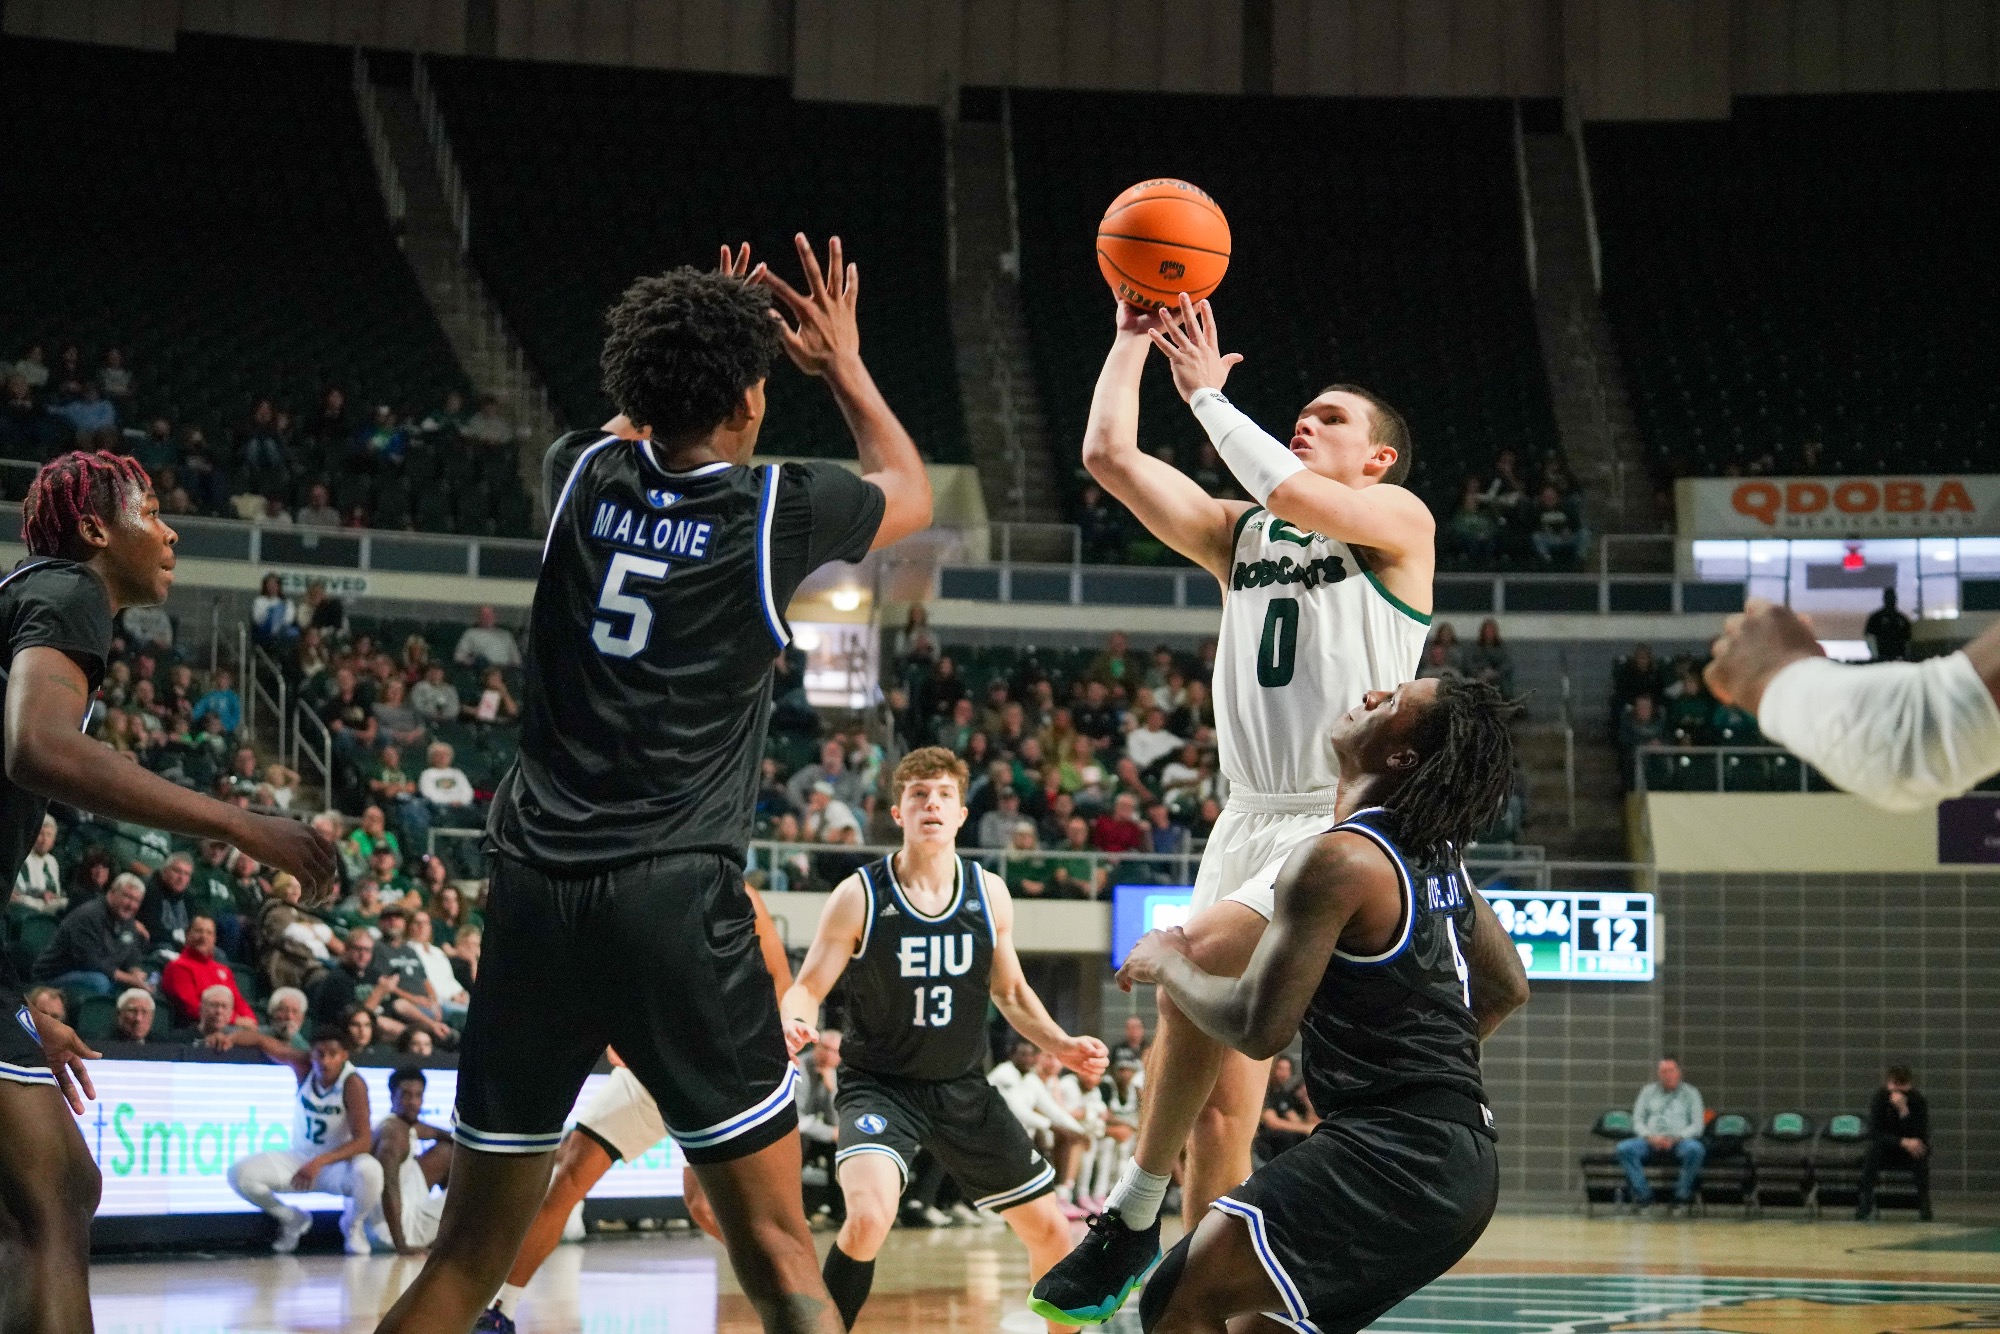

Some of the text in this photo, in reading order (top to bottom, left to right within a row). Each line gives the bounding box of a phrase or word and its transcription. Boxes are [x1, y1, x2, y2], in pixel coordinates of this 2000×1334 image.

[1119, 280, 1182, 312] Wil
[1731, 481, 1976, 526] QDOBA
[592, 502, 711, 557] MALONE
[591, 551, 670, 659] 5
[1257, 598, 1299, 688] 0
[1486, 899, 1571, 936] 3:34
[1592, 917, 1638, 951] 12
[897, 934, 973, 977] EIU
[913, 985, 953, 1026] 13
[306, 1116, 327, 1144] 12
